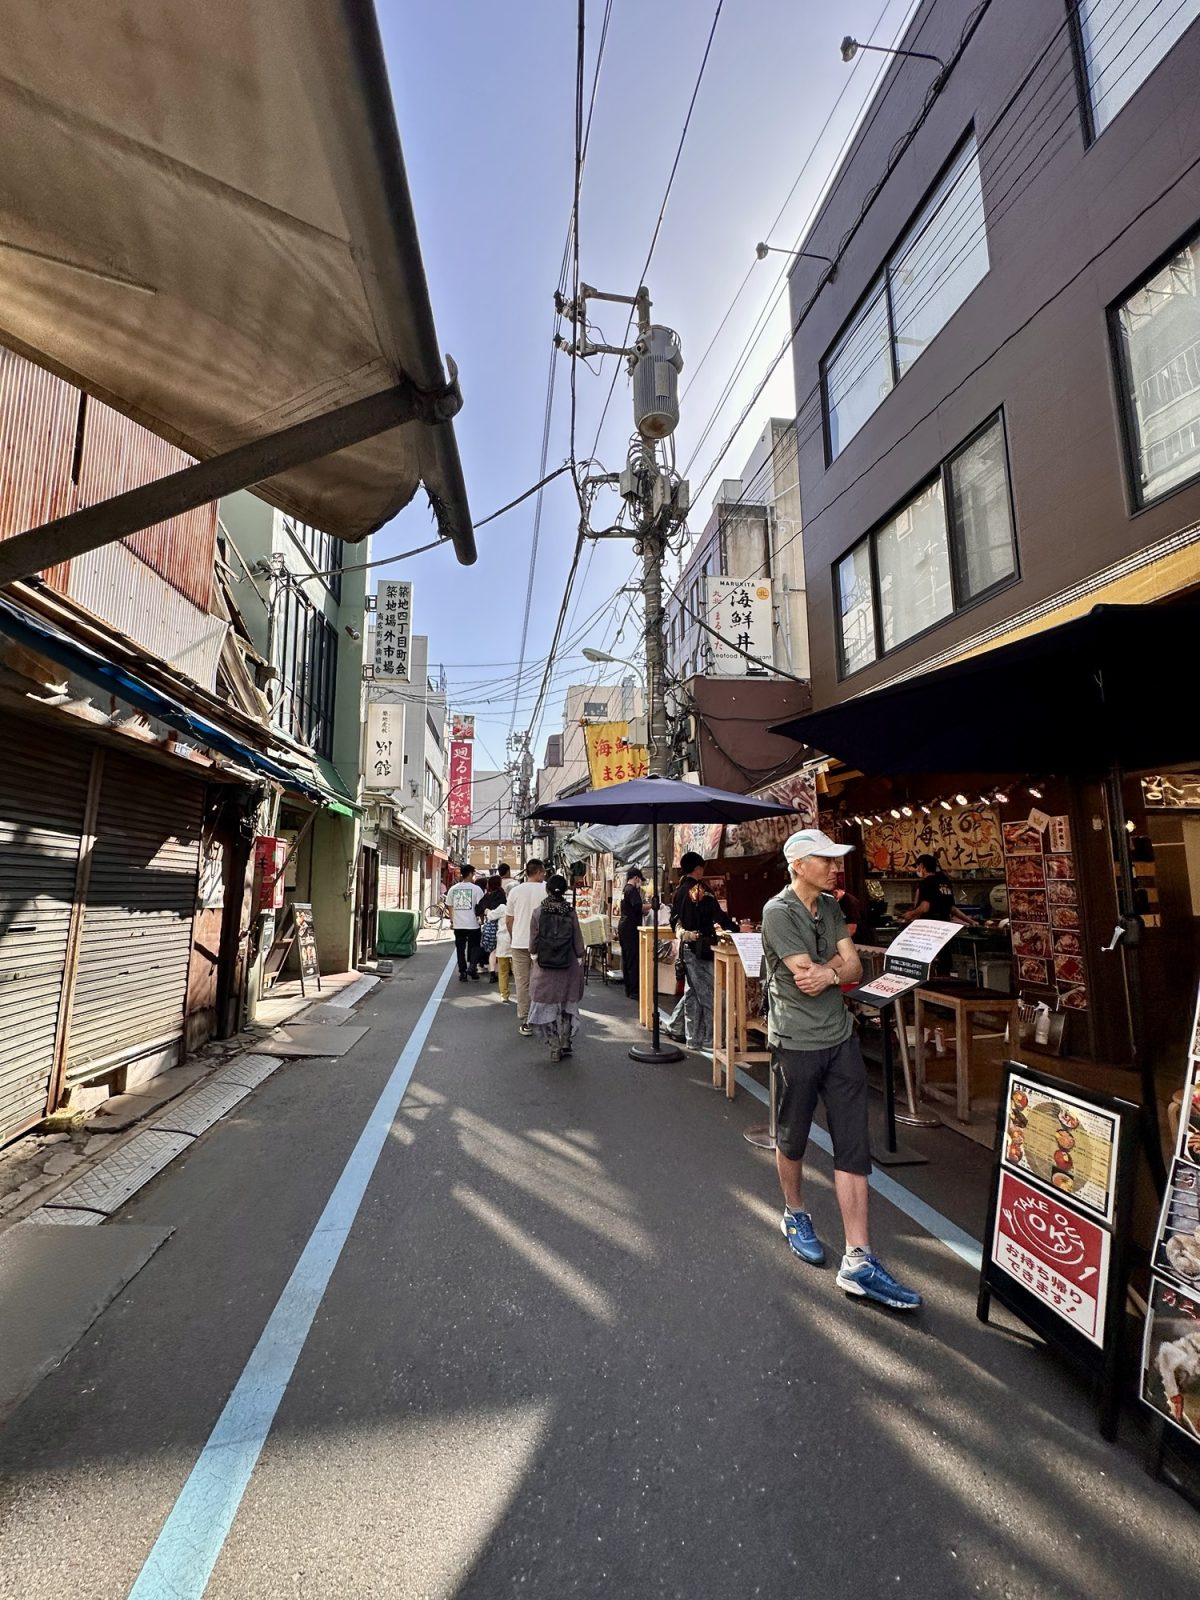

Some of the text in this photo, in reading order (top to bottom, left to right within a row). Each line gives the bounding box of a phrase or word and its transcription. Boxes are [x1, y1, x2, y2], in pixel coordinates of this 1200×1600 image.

[383, 585, 397, 675] 築地場外市場
[396, 586, 409, 675] 築地四丁目町会
[374, 740, 392, 777] 別館
[602, 761, 649, 781] まるきた
[903, 841, 994, 868] バベキュー
[868, 980, 903, 994] Closed
[1014, 1197, 1049, 1214] TAKE
[1055, 1213, 1085, 1251] OUT
[1029, 1213, 1067, 1249] OK
[1005, 1243, 1083, 1304] お持ち帰り
[1008, 1257, 1077, 1313] できます!
